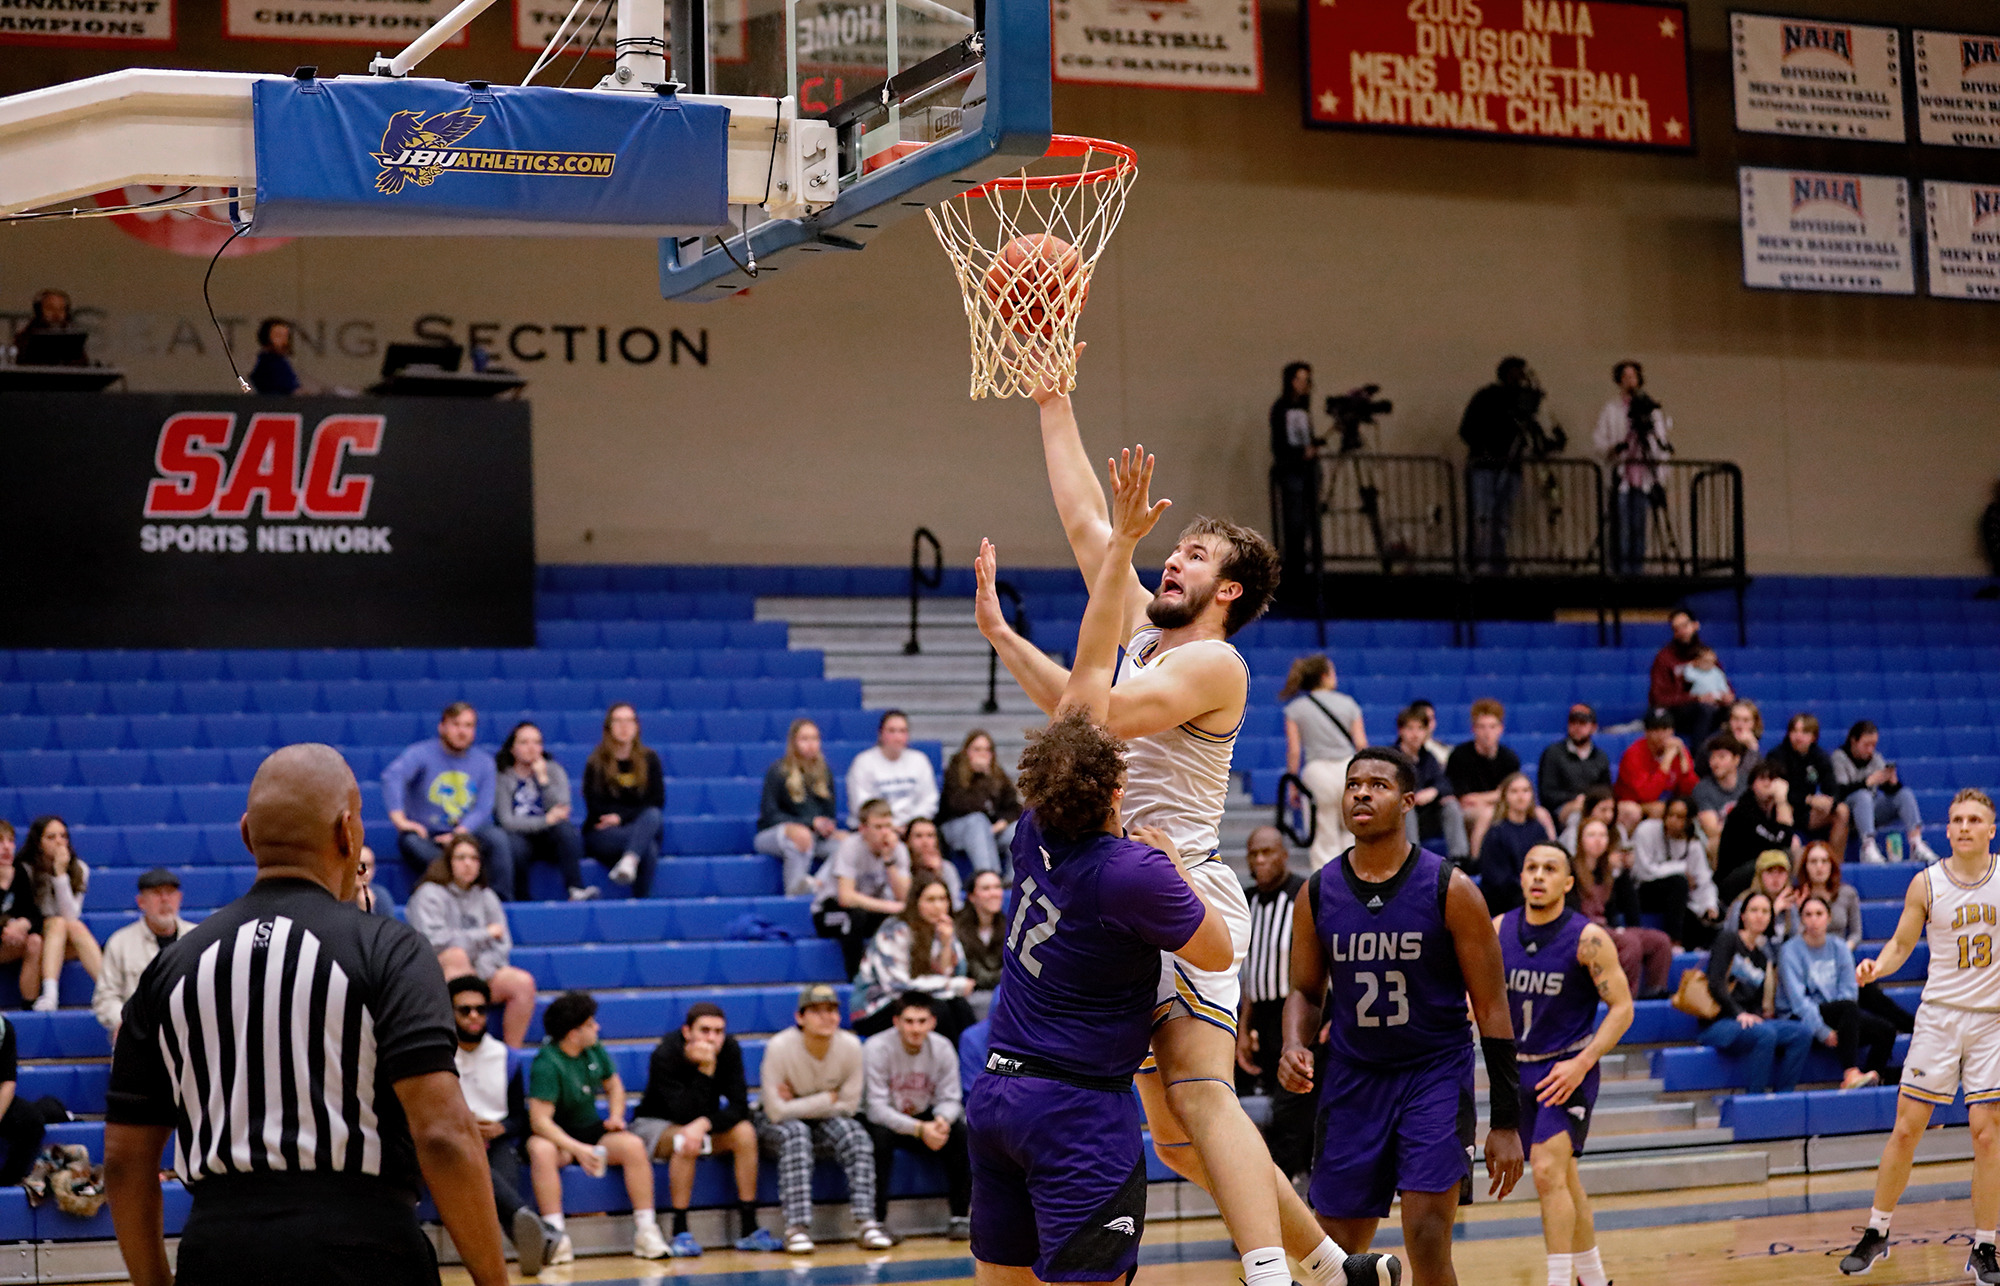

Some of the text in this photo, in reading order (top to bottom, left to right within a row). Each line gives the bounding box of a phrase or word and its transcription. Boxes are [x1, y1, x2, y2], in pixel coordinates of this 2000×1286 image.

[1407, 0, 1594, 37] 2005 NAIA
[1083, 27, 1229, 51] VOLLEYBALL
[1416, 22, 1551, 66] DIVISION
[1783, 25, 1851, 60] NAIA
[1963, 41, 2000, 67] NA
[1060, 53, 1251, 76] CO-CHAMPIONS
[1350, 50, 1641, 104] MENS BASKETBALL
[1782, 66, 1847, 84] DIVISION
[1749, 81, 1890, 105] MEN'S BASKETBALL
[1920, 96, 1985, 110] WOMEN'S
[1353, 86, 1653, 141] NATIONAL CHAMPION
[1793, 178, 1860, 212] NAIA
[1790, 220, 1857, 235] DIVISION
[1807, 239, 1900, 256] BASKETBALL
[143, 411, 387, 519] SAC
[140, 524, 391, 554] SPORTS NETWORK
[1006, 875, 1061, 979] 12
[1951, 903, 1997, 930] JBU
[1332, 932, 1423, 962] LIONS
[1957, 933, 1992, 969] 13
[1506, 968, 1565, 996] IONS
[1354, 970, 1410, 1027] 23
[1521, 1000, 1533, 1042] 1
